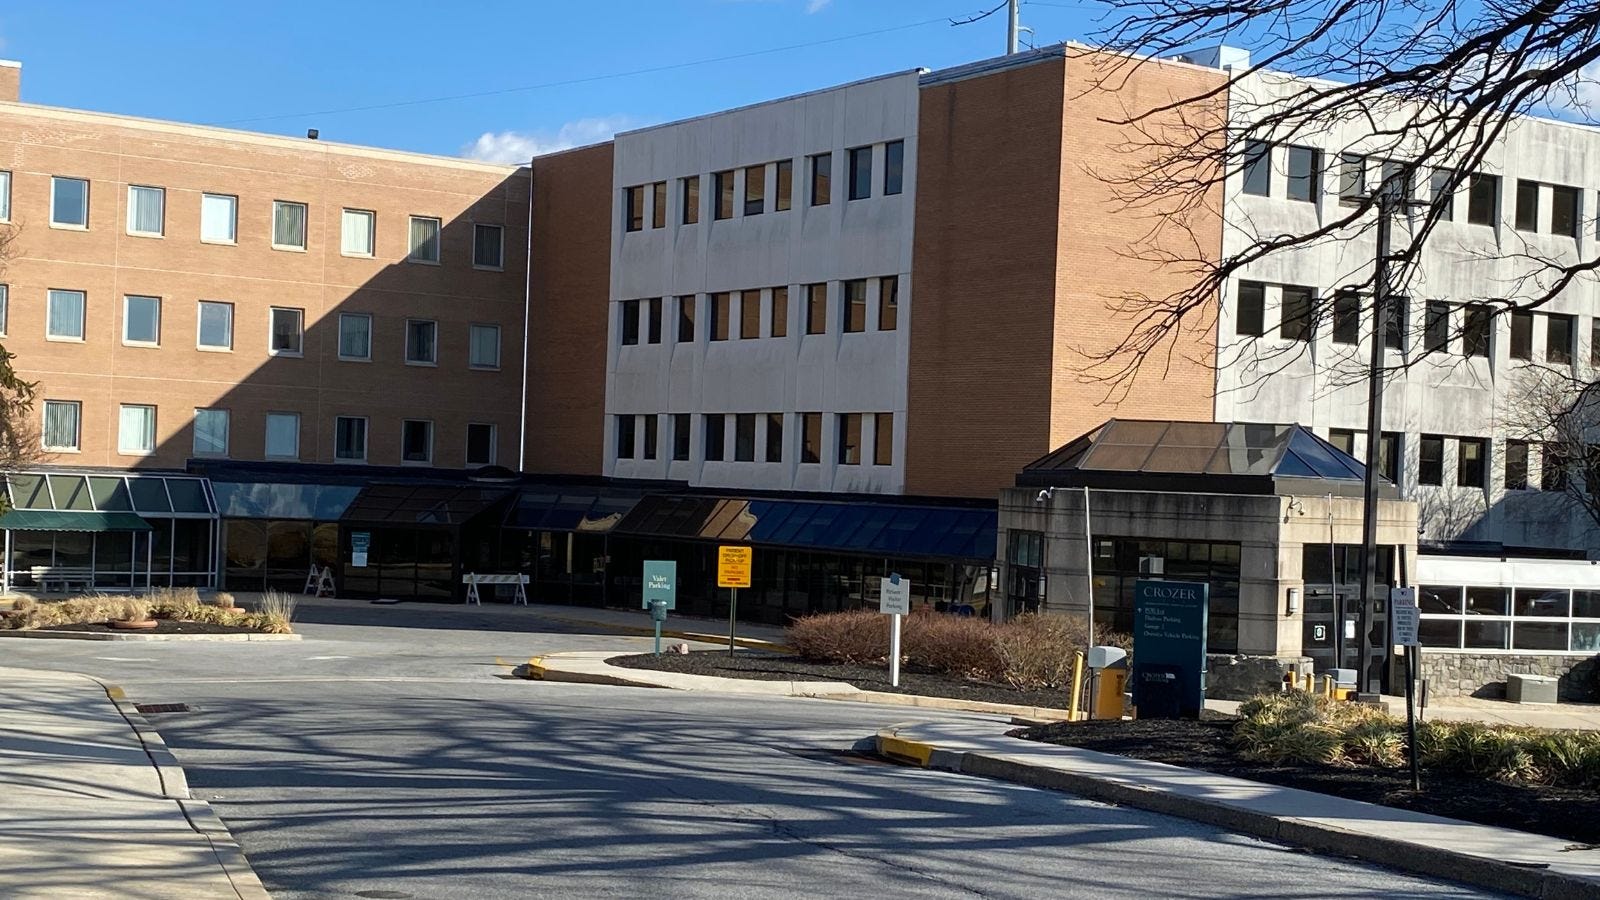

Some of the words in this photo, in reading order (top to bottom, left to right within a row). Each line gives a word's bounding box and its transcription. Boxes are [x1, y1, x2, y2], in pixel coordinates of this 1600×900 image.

[652, 574, 667, 582] Valet
[648, 581, 671, 590] Parking
[1143, 586, 1197, 600] CROZER
